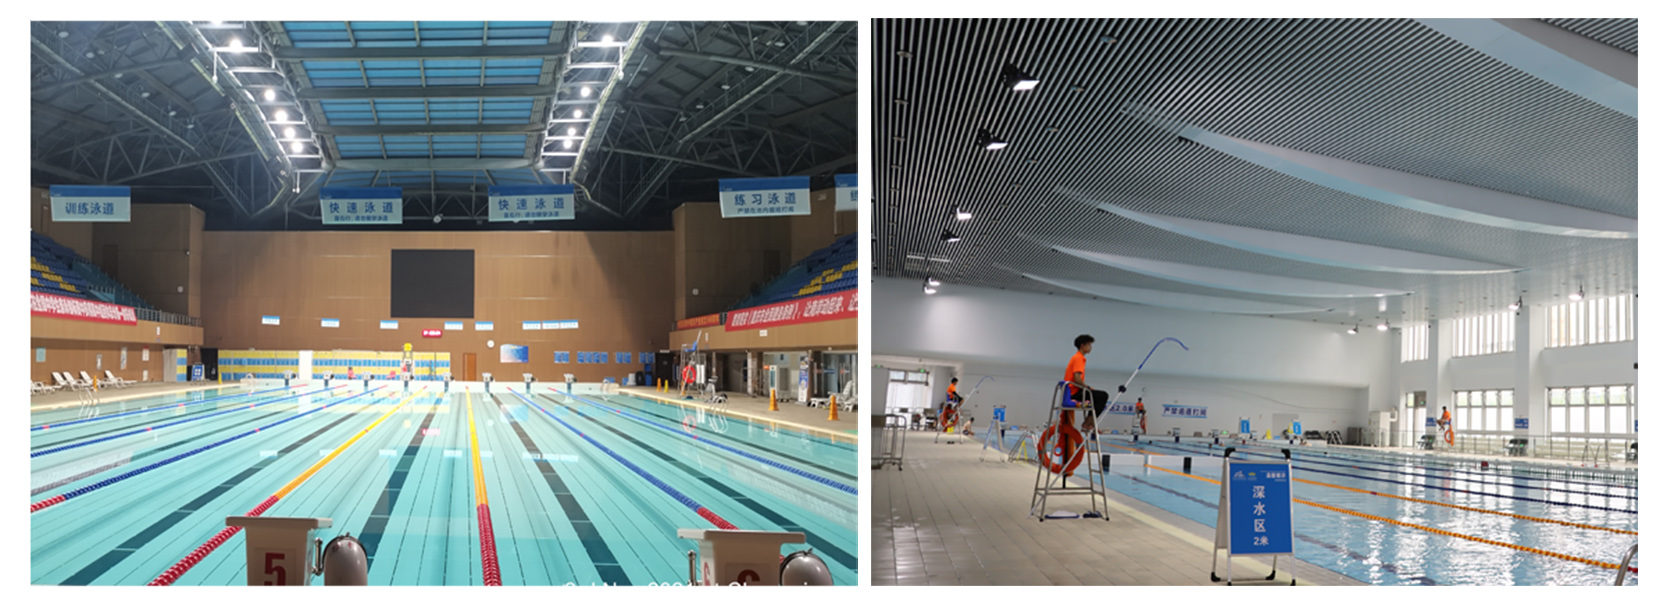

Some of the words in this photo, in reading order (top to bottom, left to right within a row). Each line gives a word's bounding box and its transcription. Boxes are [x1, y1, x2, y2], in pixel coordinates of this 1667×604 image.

[498, 197, 564, 210] 快速泳道
[734, 192, 796, 206] 练习泳道
[65, 202, 114, 215] 训练泳道
[329, 202, 393, 213] 快速泳道
[1252, 485, 1266, 532] 深水区
[1253, 536, 1269, 546] 2米
[264, 552, 287, 586] 5
